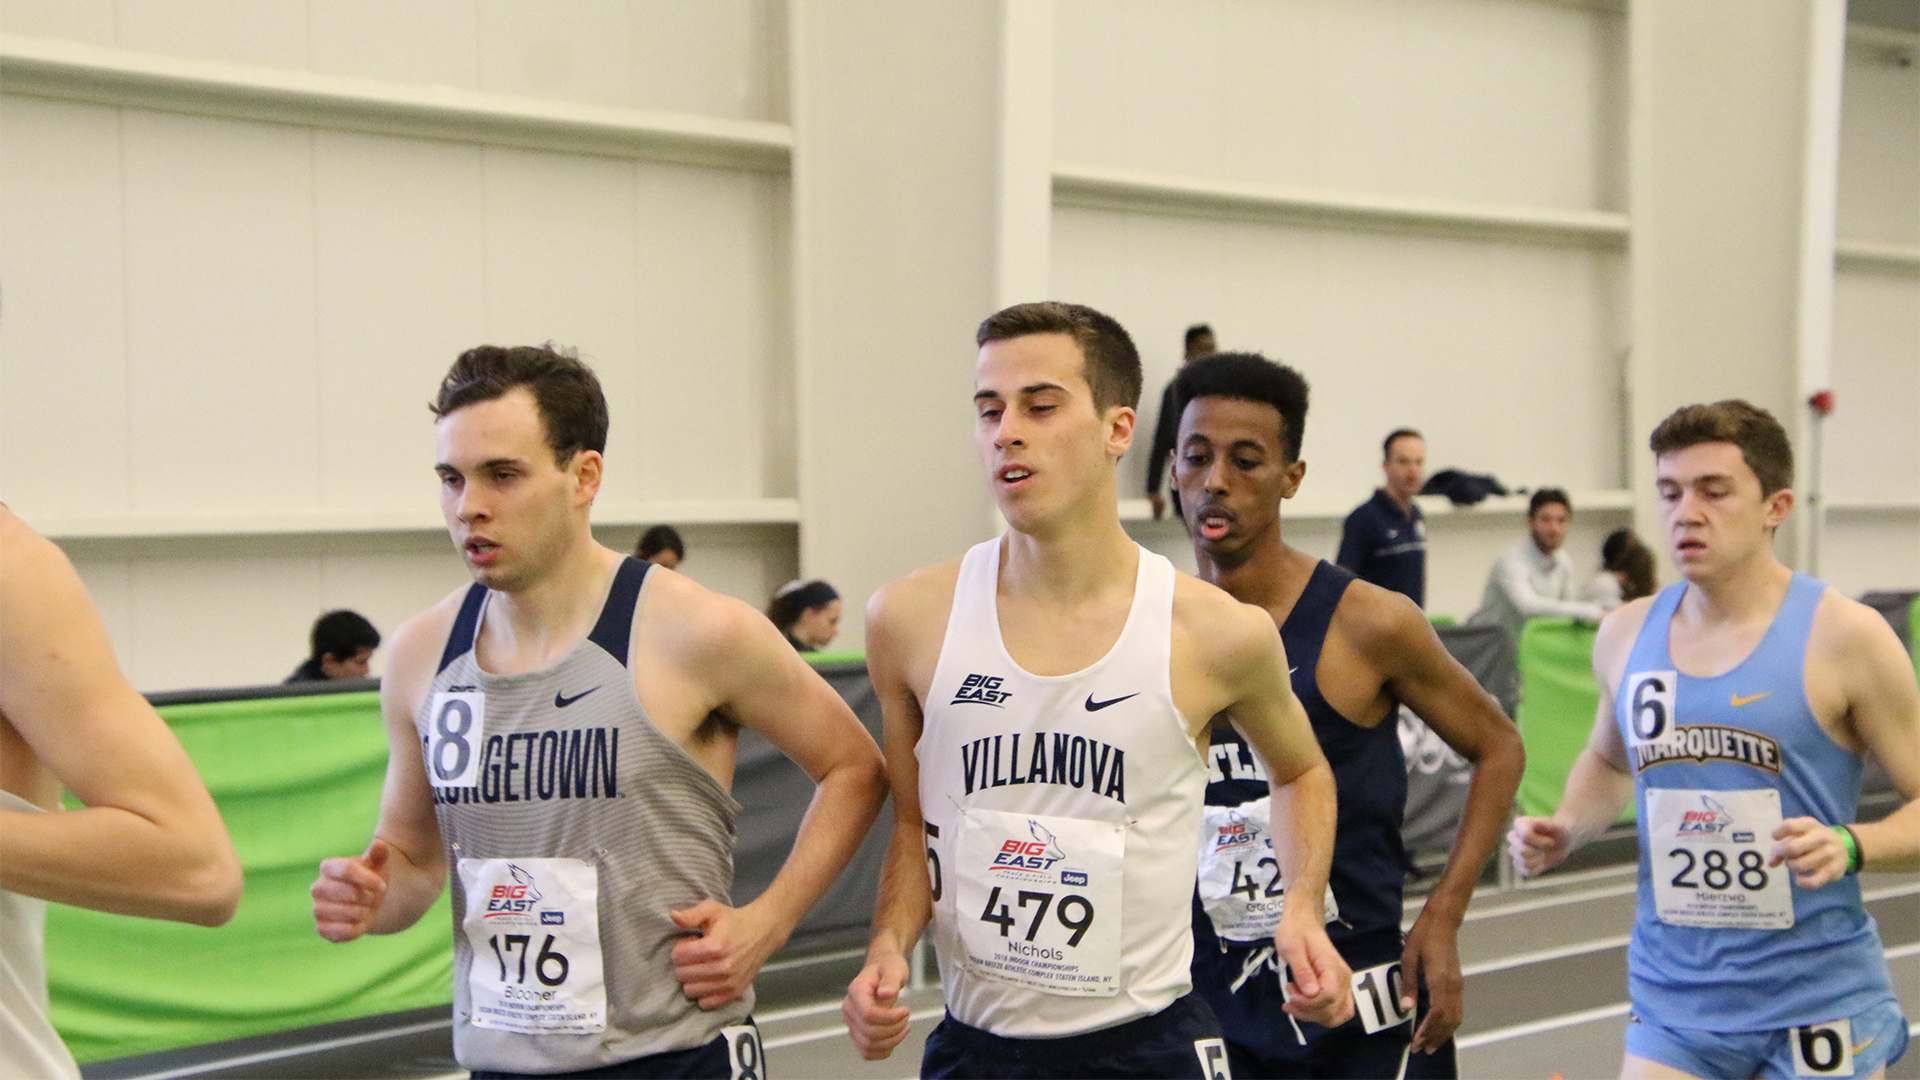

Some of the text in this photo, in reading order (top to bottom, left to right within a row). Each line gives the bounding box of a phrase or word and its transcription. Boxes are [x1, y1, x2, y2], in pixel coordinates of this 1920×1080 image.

[962, 673, 1004, 689] BIG
[954, 687, 1013, 704] EAST
[1631, 677, 1667, 741] 6
[433, 699, 473, 781] 8
[424, 727, 619, 805] GETOWN
[961, 732, 1126, 804] VILLANOVA
[1683, 811, 1718, 823] BIG
[1679, 822, 1728, 833] EAST
[1000, 839, 1047, 856] BIG
[1217, 832, 1260, 846] EAST
[993, 852, 1059, 870] EAST
[1668, 848, 1769, 891] 288
[1230, 857, 1285, 901] 42
[491, 885, 528, 899] BIG
[487, 899, 537, 911] EAST
[980, 886, 1094, 948] 479
[1008, 941, 1064, 961] Nichols
[489, 934, 569, 987] 176
[1031, 960, 1079, 972] CHAMPIONSHIPS
[1028, 969, 1054, 980] COMPLEX
[1055, 973, 1076, 981] STATEN
[1103, 975, 1113, 983] NY
[505, 985, 557, 1001] Bloomer
[1356, 964, 1409, 1027] 10
